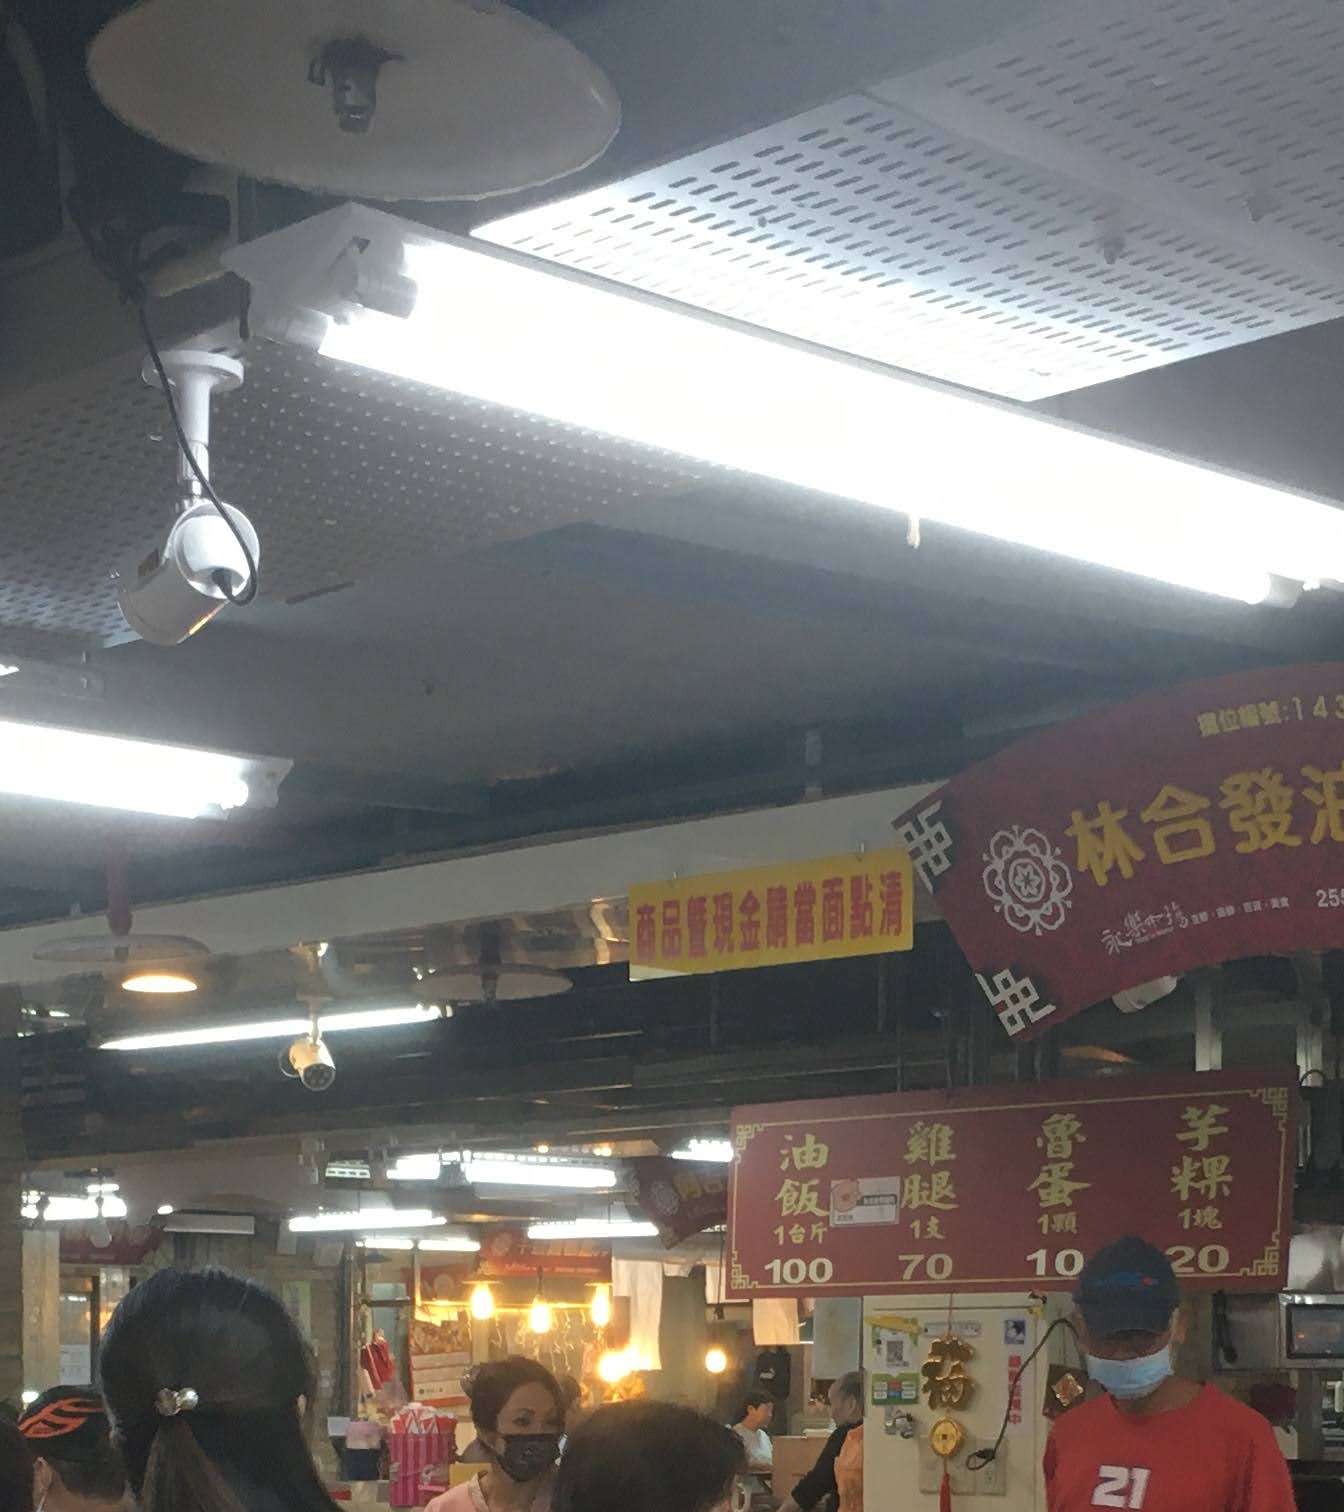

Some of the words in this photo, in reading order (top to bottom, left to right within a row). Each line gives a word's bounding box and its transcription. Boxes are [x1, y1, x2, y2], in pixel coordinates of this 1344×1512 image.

[901, 1121, 960, 1210] 雞腿
[1170, 1104, 1234, 1201] 芋粿
[774, 1133, 830, 1217] 油飯
[773, 1221, 828, 1246] 1台斤
[764, 1257, 833, 1285] 100
[898, 1253, 953, 1281] 70
[1026, 1248, 1085, 1277] 10
[1164, 1244, 1230, 1274] 20
[1091, 1465, 1152, 1510] 21
